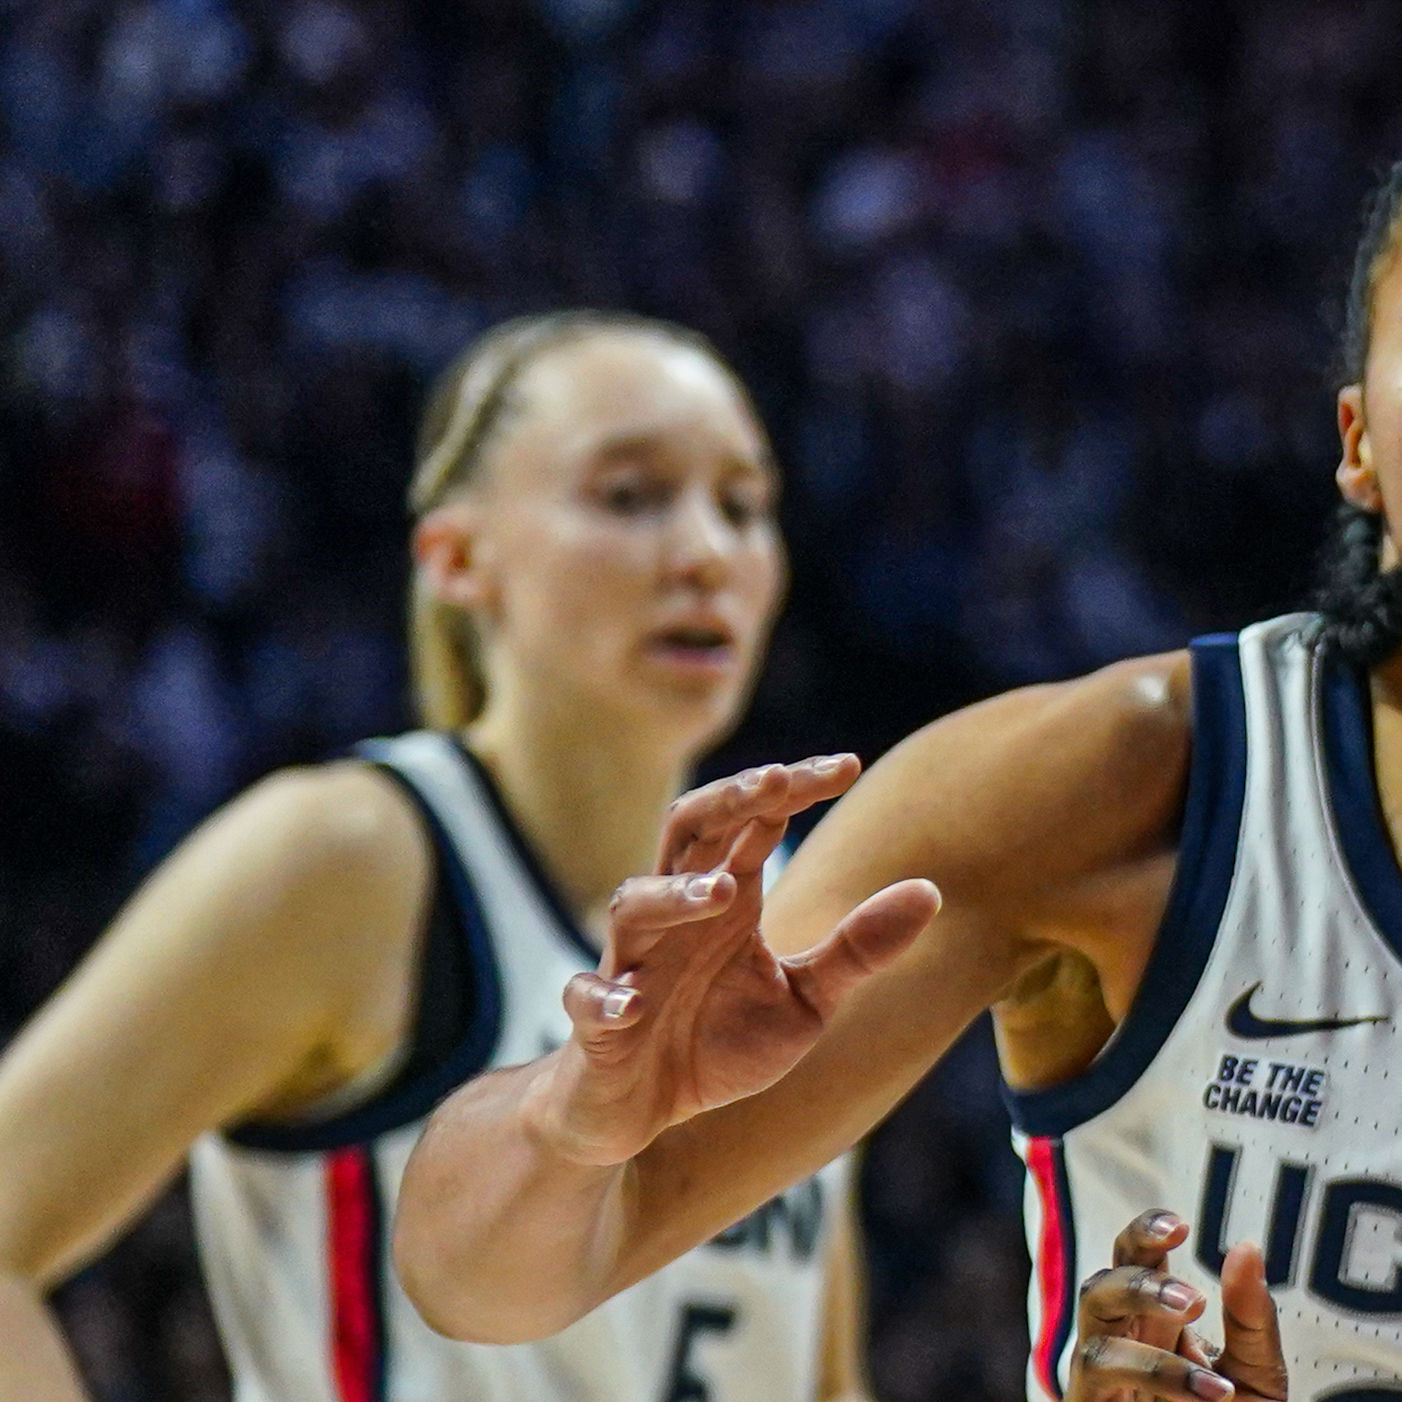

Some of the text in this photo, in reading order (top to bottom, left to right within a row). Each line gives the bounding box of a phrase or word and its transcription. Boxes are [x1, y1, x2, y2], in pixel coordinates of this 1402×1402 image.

[1217, 1054, 1325, 1097] BE THE
[1203, 1082, 1323, 1128] CHANGE
